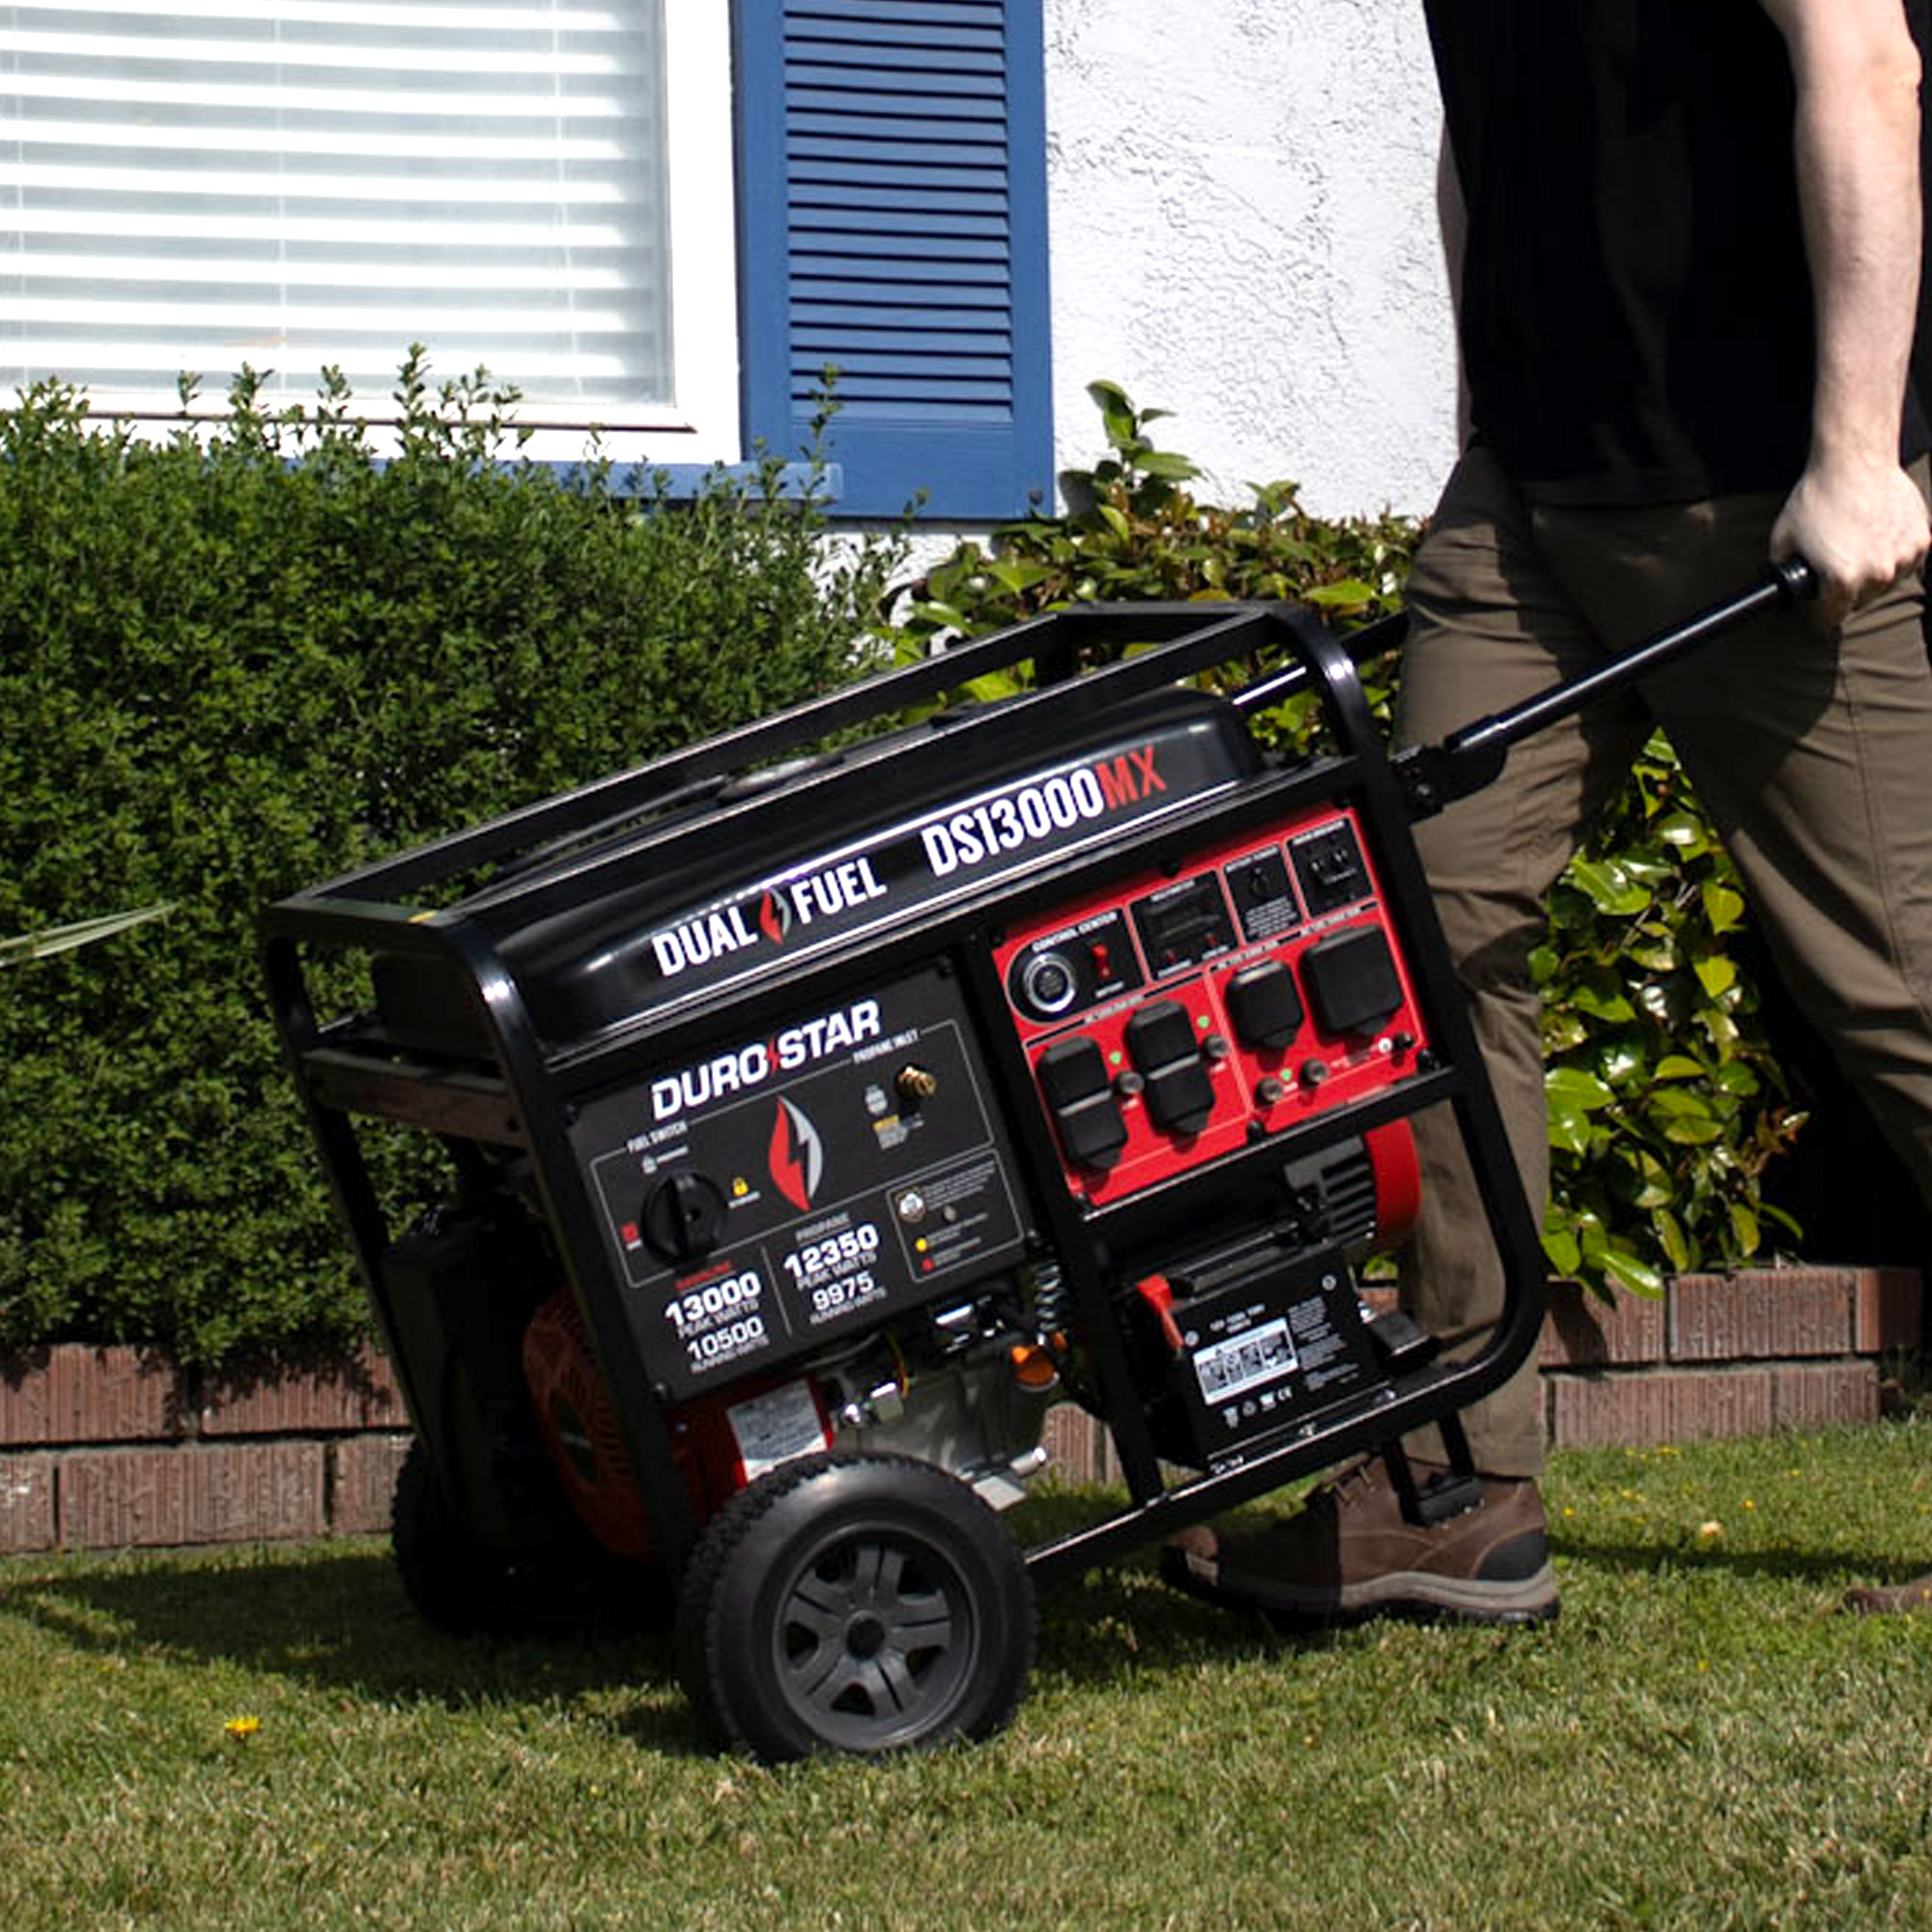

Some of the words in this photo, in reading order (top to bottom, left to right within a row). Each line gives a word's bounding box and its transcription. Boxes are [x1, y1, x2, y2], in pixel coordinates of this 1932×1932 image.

[652, 907, 757, 977] DUAL
[790, 858, 886, 924] FUEL
[922, 746, 1166, 876] DS13000MX
[782, 1223, 878, 1278] 12350
[796, 1270, 830, 1291] PEAK
[831, 1251, 876, 1276] WATTS
[664, 1272, 761, 1327] 13000
[812, 1272, 874, 1311] 9975
[677, 1318, 713, 1338] PEAK
[714, 1299, 758, 1324] WATTS
[687, 1316, 764, 1361] 10500
